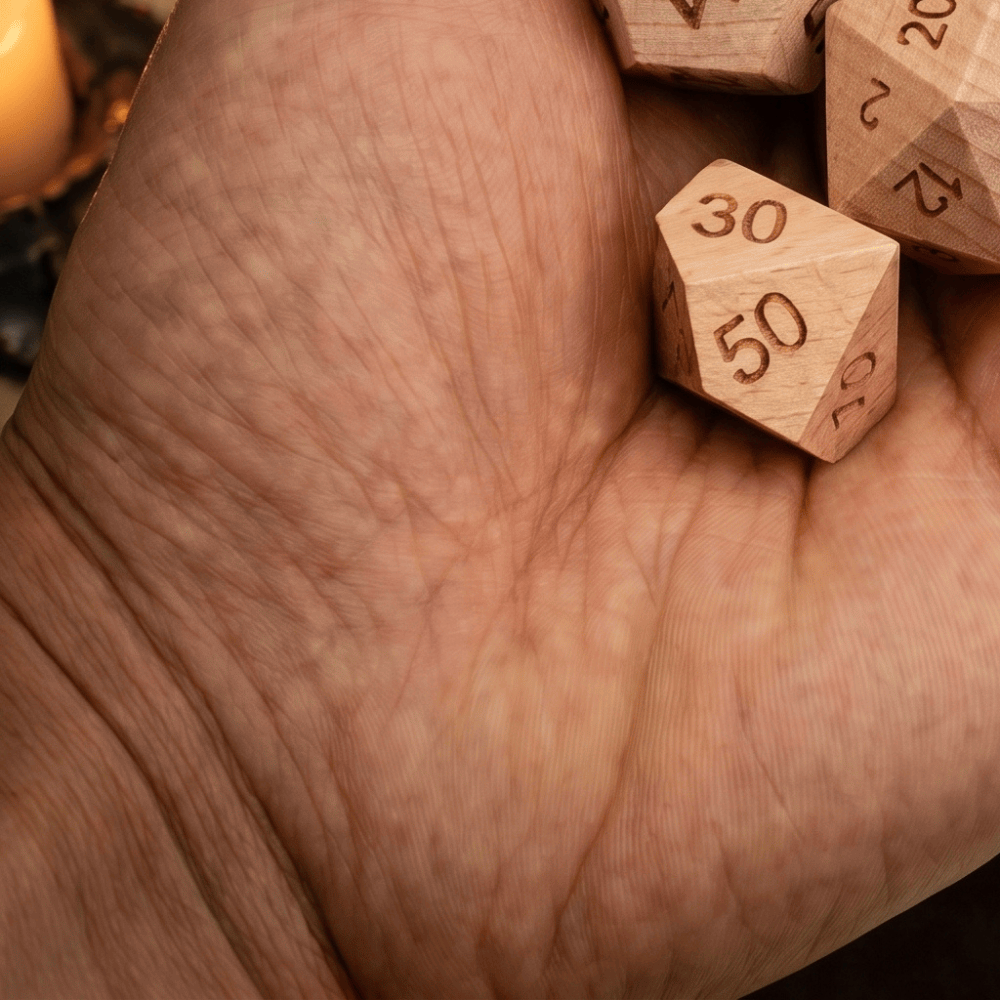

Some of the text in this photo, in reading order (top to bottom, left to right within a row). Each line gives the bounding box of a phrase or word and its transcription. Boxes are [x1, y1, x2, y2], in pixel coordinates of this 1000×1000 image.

[859, 77, 891, 131] 2
[893, 162, 963, 218] 12
[691, 192, 788, 244] 30
[713, 291, 808, 385] 50
